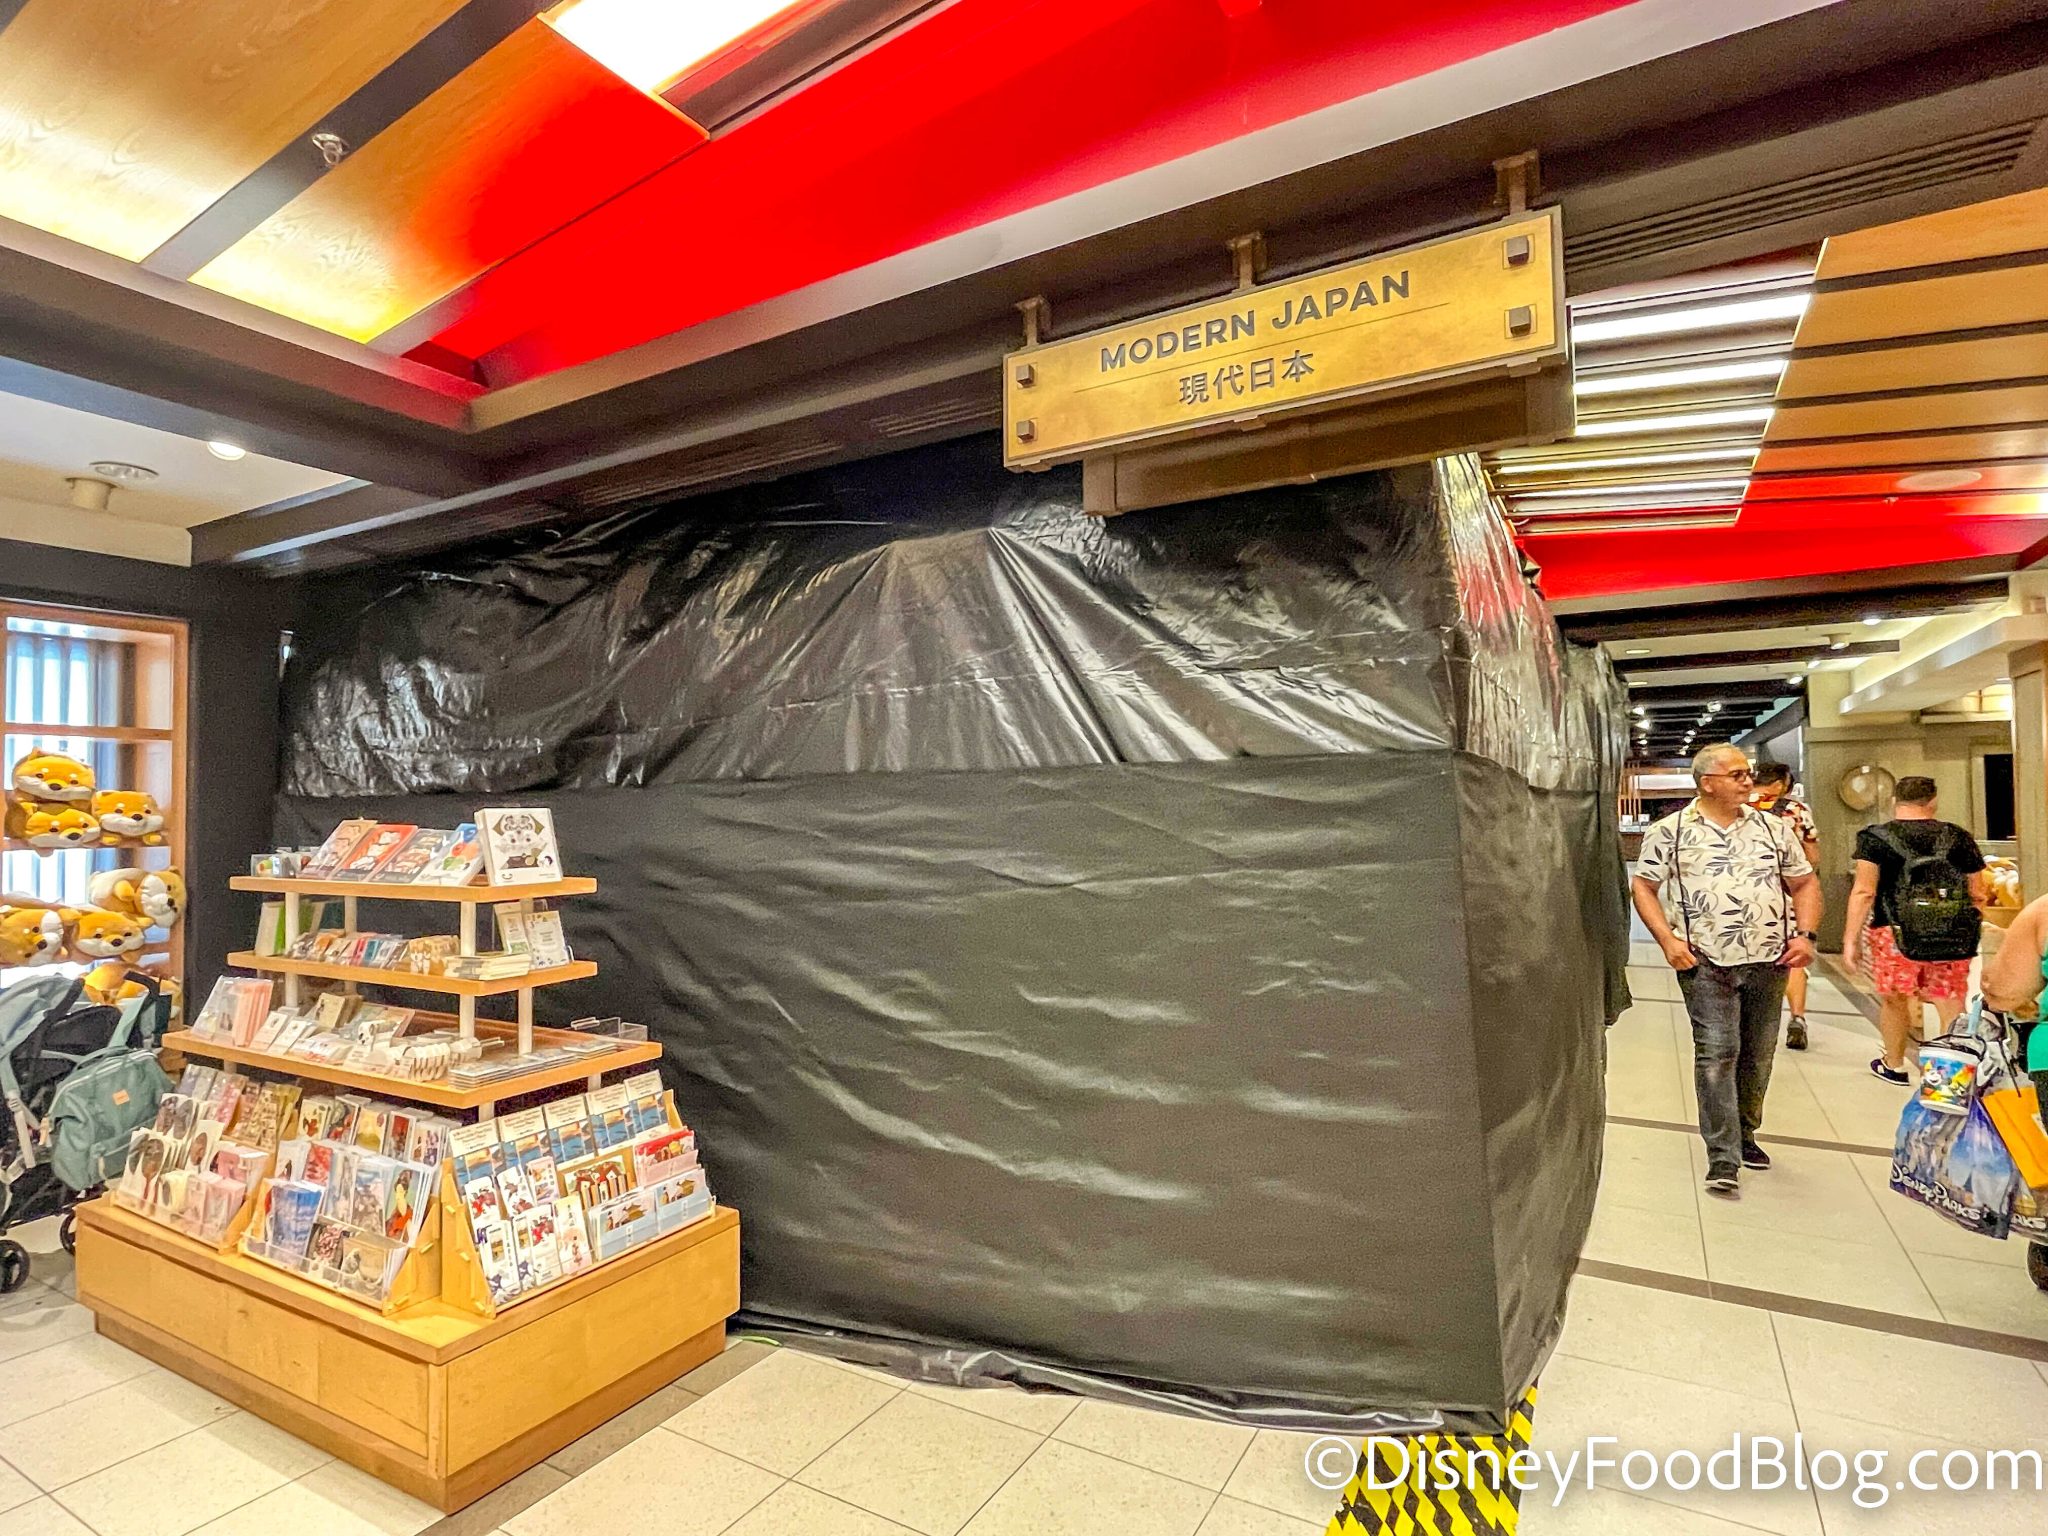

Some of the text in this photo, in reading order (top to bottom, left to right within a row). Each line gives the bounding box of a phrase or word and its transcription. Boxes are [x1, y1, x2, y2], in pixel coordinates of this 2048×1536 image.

[1101, 270, 1409, 372] MODERN JAPAN
[1178, 349, 1316, 405] 現代日本
